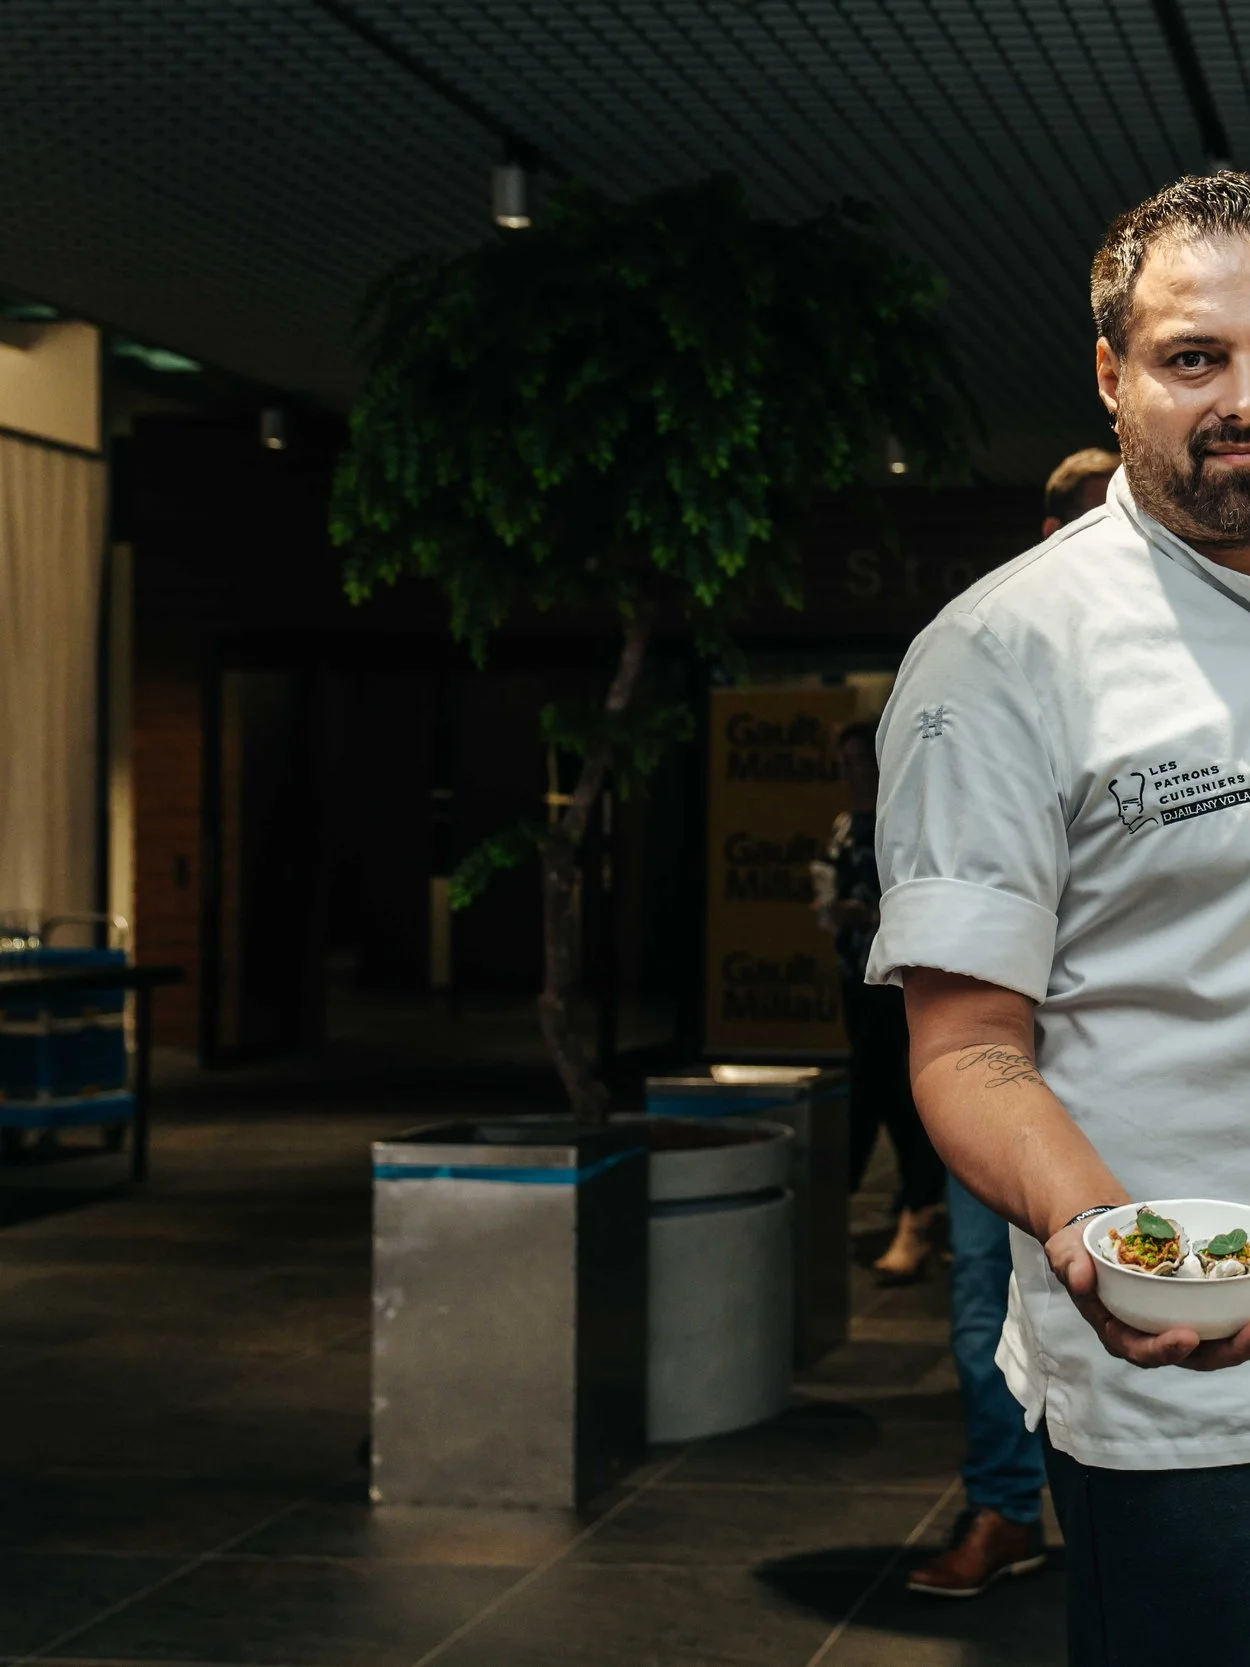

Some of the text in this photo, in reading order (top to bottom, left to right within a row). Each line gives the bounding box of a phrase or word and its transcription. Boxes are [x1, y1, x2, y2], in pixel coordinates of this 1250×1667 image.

[1149, 760, 1178, 776] LES
[1153, 765, 1220, 791] PATRONS
[1159, 774, 1246, 805] CUISINIERS
[1163, 801, 1218, 822] DJAILANY
[1219, 794, 1236, 807] VD
[723, 867, 813, 902] Milla
